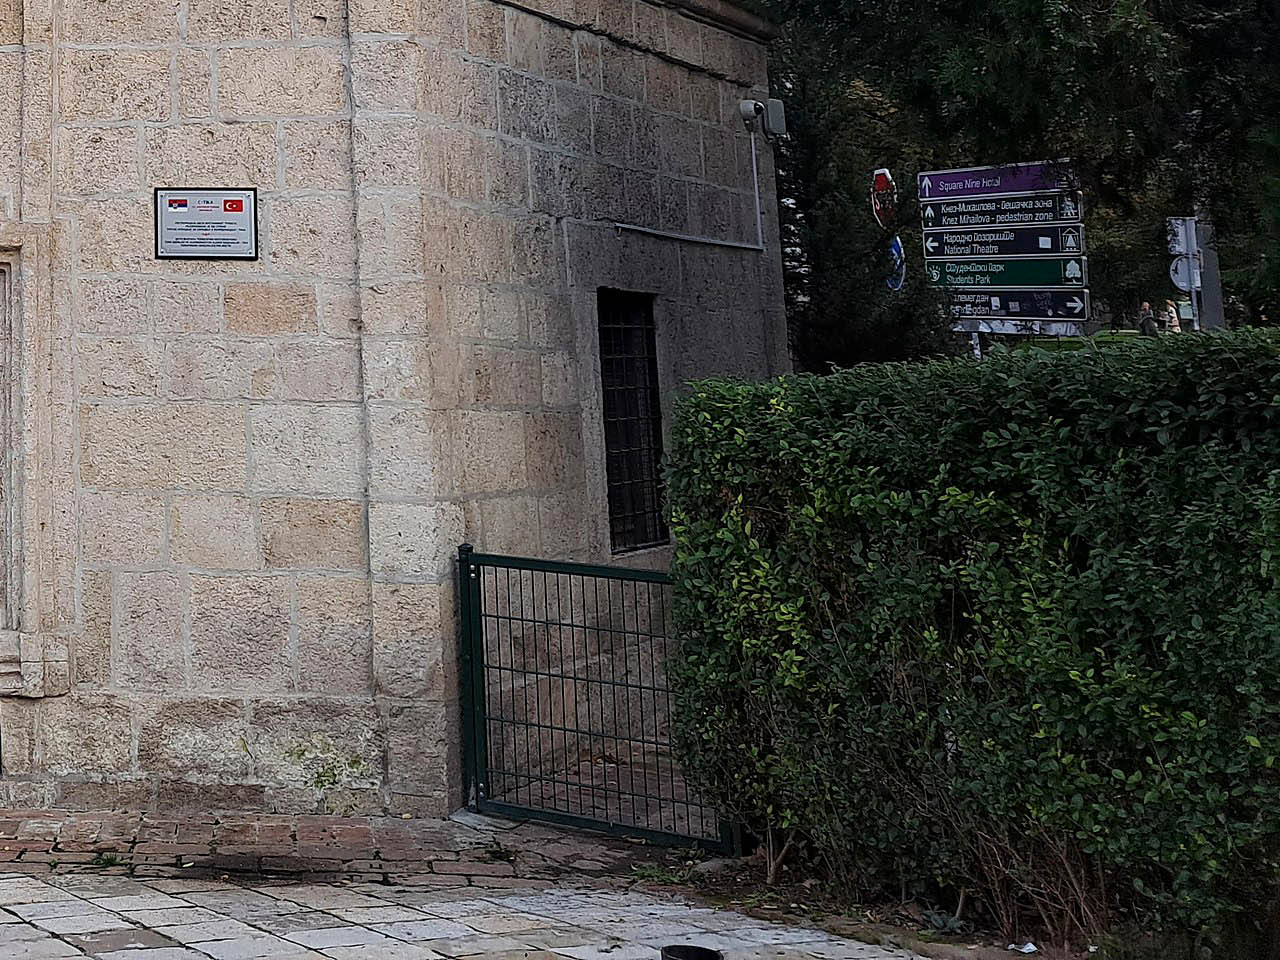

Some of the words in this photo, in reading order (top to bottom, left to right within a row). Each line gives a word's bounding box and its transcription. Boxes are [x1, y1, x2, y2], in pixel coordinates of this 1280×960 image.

[938, 180, 963, 192] Square
[964, 178, 981, 189] Nine
[942, 215, 958, 225] Knez
[959, 213, 990, 224] Mihailova
[995, 212, 1033, 224] pedestrian
[1034, 211, 1054, 221] zone
[943, 233, 972, 244] Народно
[944, 244, 971, 255] National
[972, 243, 999, 254] Theatre
[946, 274, 974, 285] Students
[975, 274, 991, 284] Park
